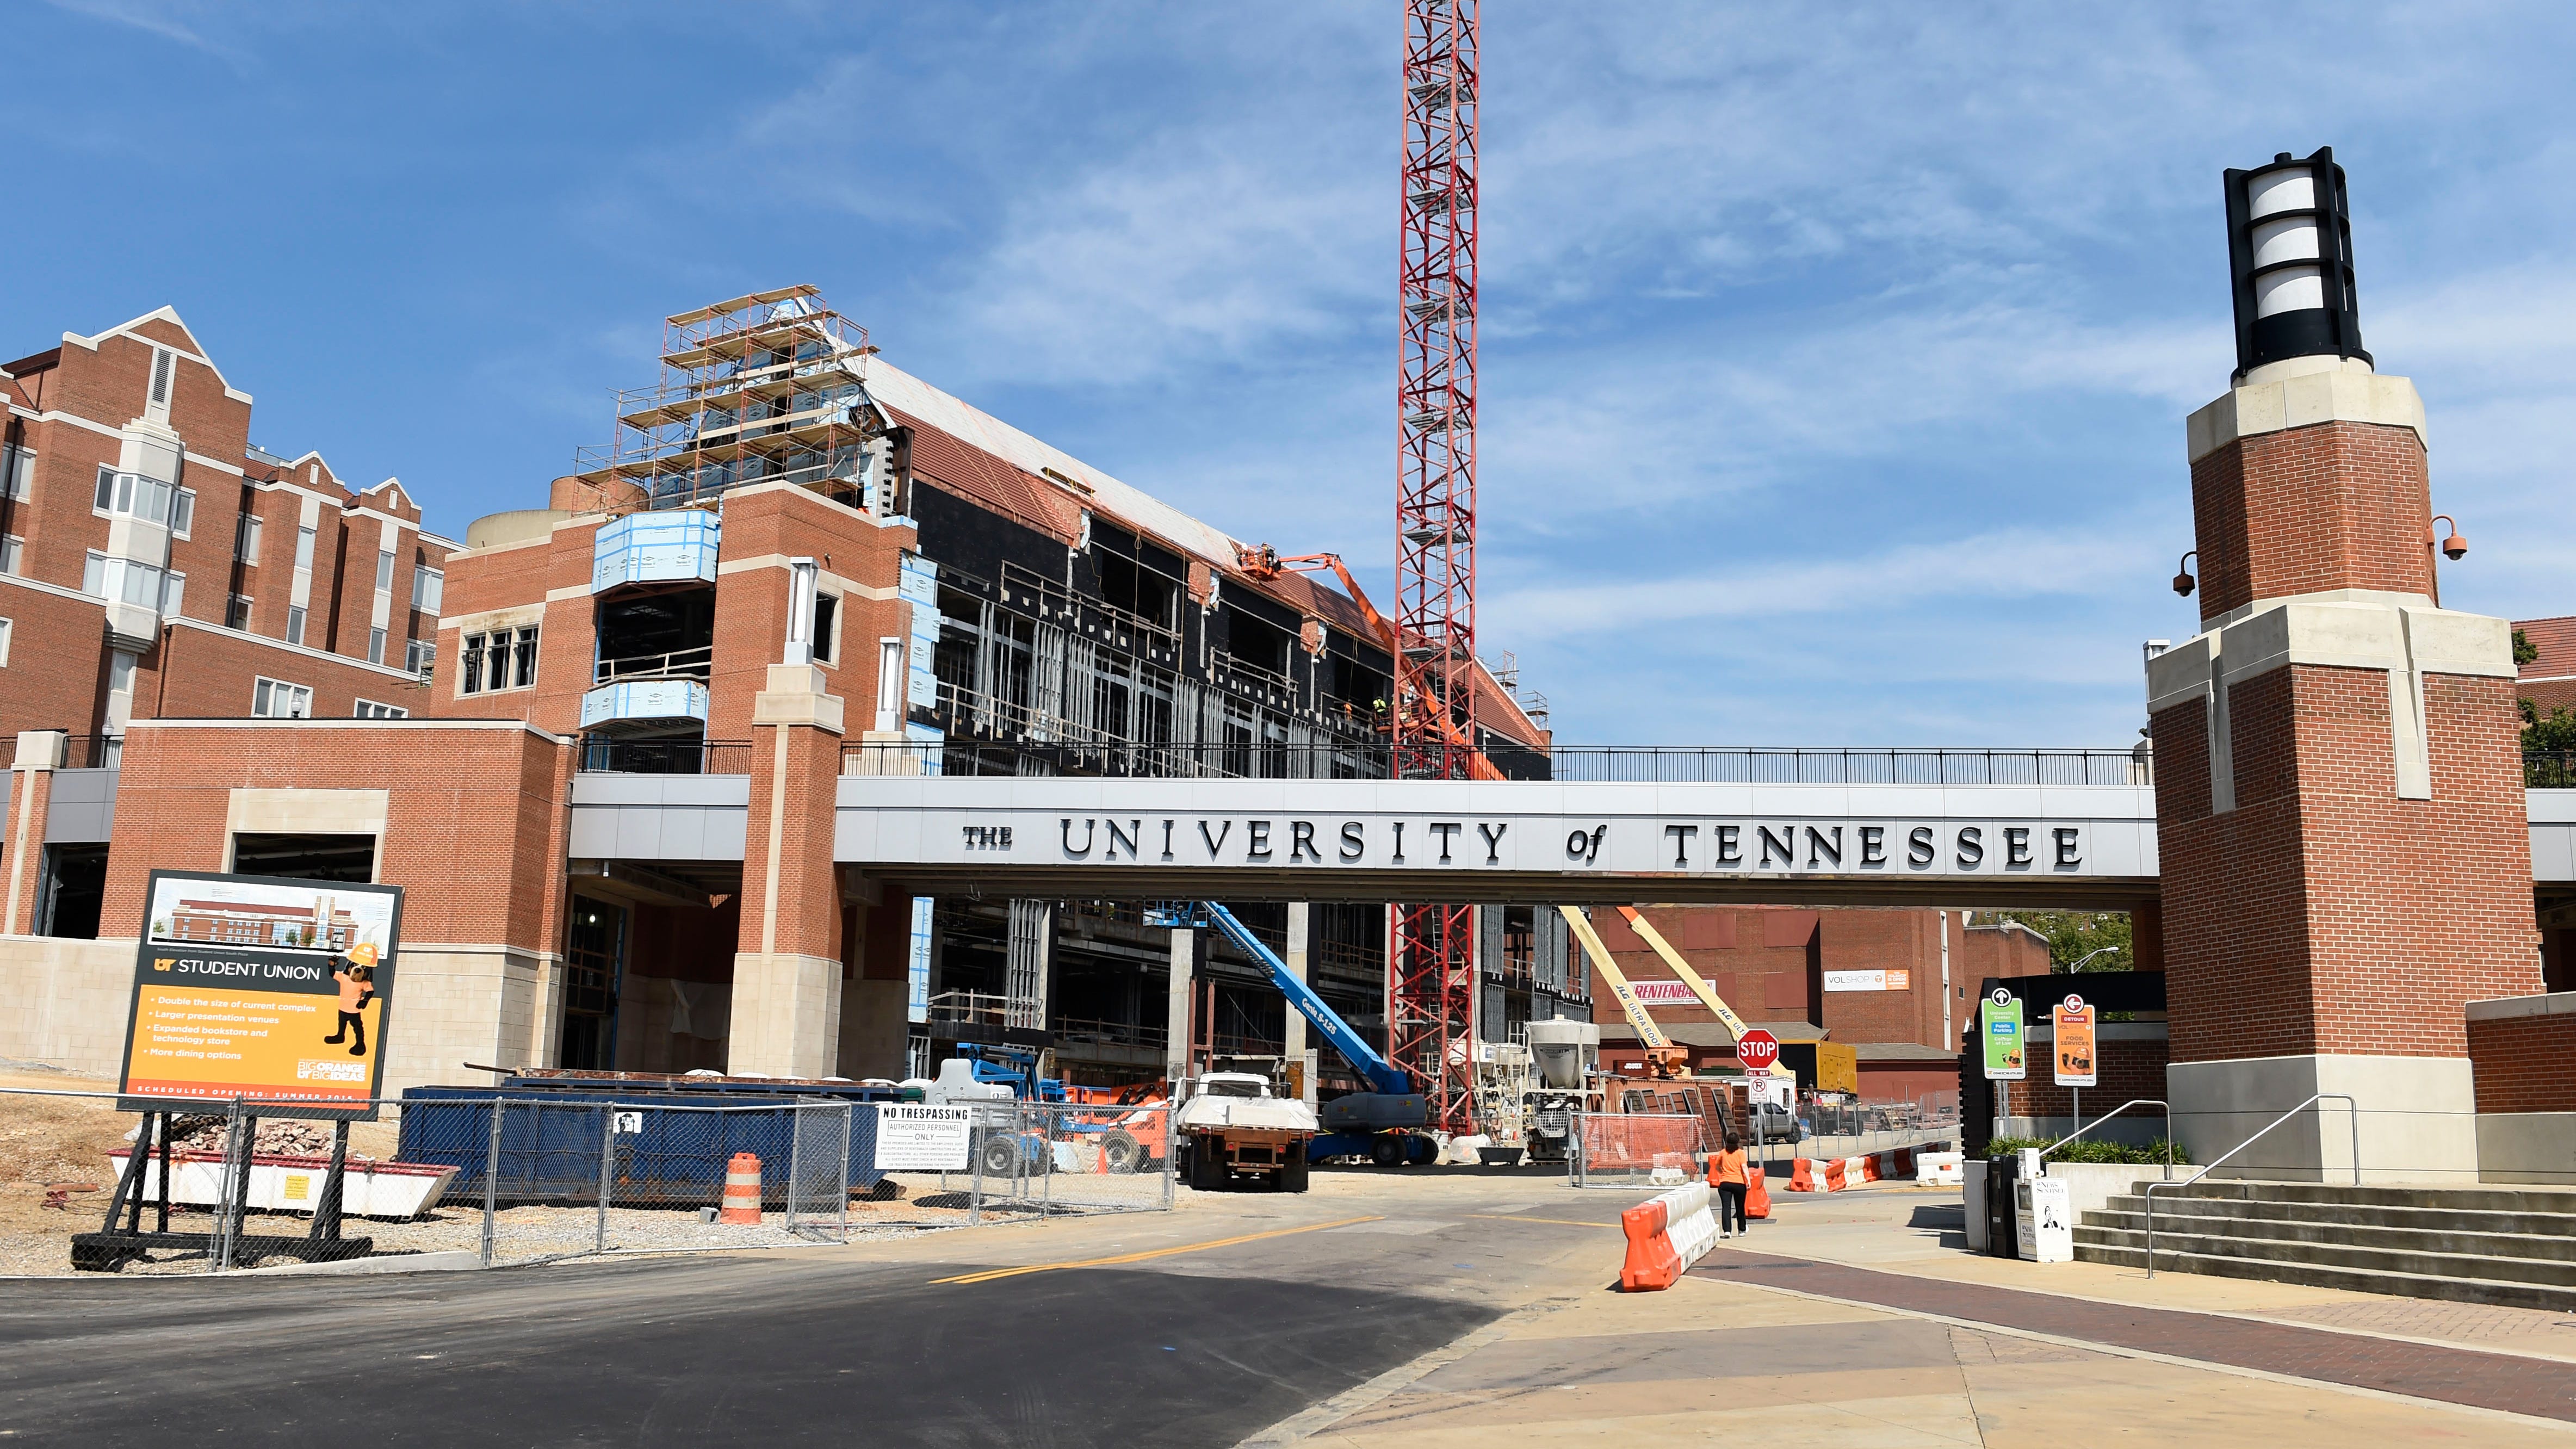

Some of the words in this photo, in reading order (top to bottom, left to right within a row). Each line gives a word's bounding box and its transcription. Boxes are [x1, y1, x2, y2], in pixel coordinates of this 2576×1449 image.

[963, 826, 1012, 846] THE
[1060, 818, 1507, 859] UNIVERSITY
[1566, 825, 1607, 860] of
[1664, 825, 2082, 866] TENNESSEE
[178, 959, 260, 976] STUDENT
[264, 965, 320, 980] UNION
[1828, 975, 1870, 983] VOLSHOP
[1634, 983, 1710, 999] RENTENBA
[158, 996, 191, 1005] Double
[243, 1001, 276, 1010] current
[278, 1004, 317, 1012] complex
[1615, 985, 1631, 1000] JLG
[1628, 1002, 1646, 1026] ULTRA
[155, 1011, 185, 1020] Larger
[187, 1012, 245, 1022] presentation
[1302, 998, 1317, 1018] Genie
[1317, 1013, 1337, 1035] S-125
[1718, 1008, 1733, 1020] JLG
[1733, 1022, 1746, 1036] ULT
[153, 1024, 200, 1034] Expanded
[202, 1026, 248, 1036] bookstore
[152, 1035, 205, 1045] technology
[150, 1048, 174, 1056] More
[176, 1049, 205, 1059] dining
[207, 1051, 242, 1060] options
[1740, 1041, 1776, 1057] STOP
[137, 1086, 205, 1094] SCHEDULED
[212, 1089, 268, 1098] OPENING:
[883, 1107, 896, 1118] NO
[901, 1108, 968, 1120] TRESPASSING
